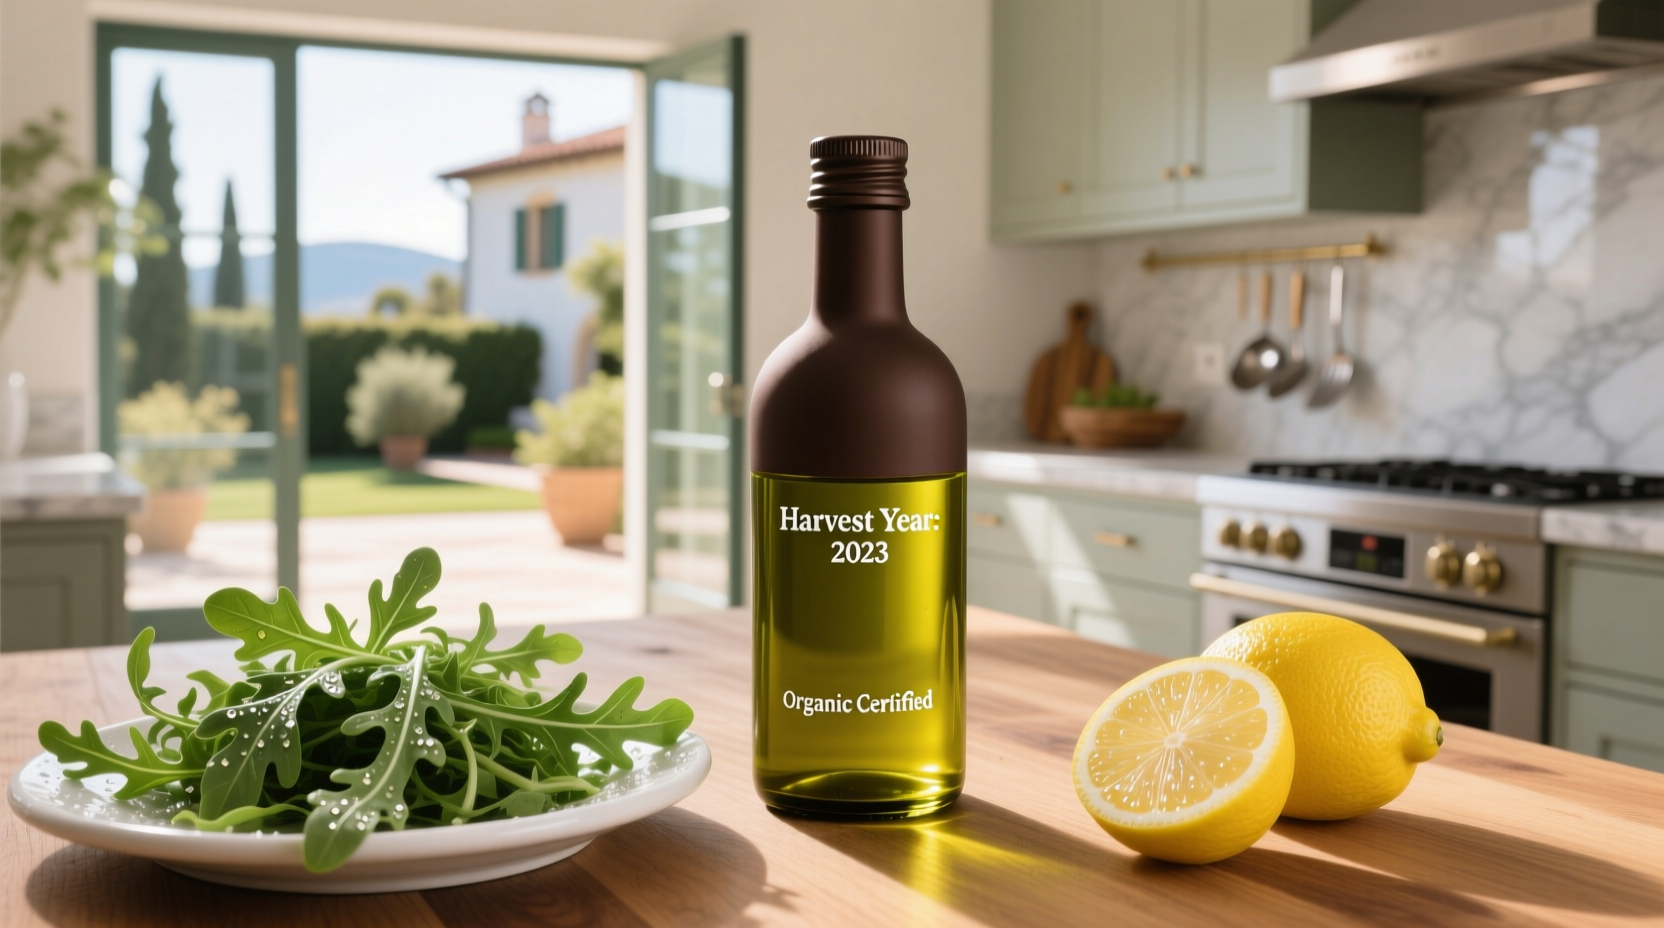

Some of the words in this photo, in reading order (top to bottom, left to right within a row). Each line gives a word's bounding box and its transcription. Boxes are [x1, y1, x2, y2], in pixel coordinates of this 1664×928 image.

[779, 506, 874, 532] Harvest
[879, 507, 940, 532] Year:
[831, 541, 889, 563] 2023
[783, 690, 852, 716] Organic
